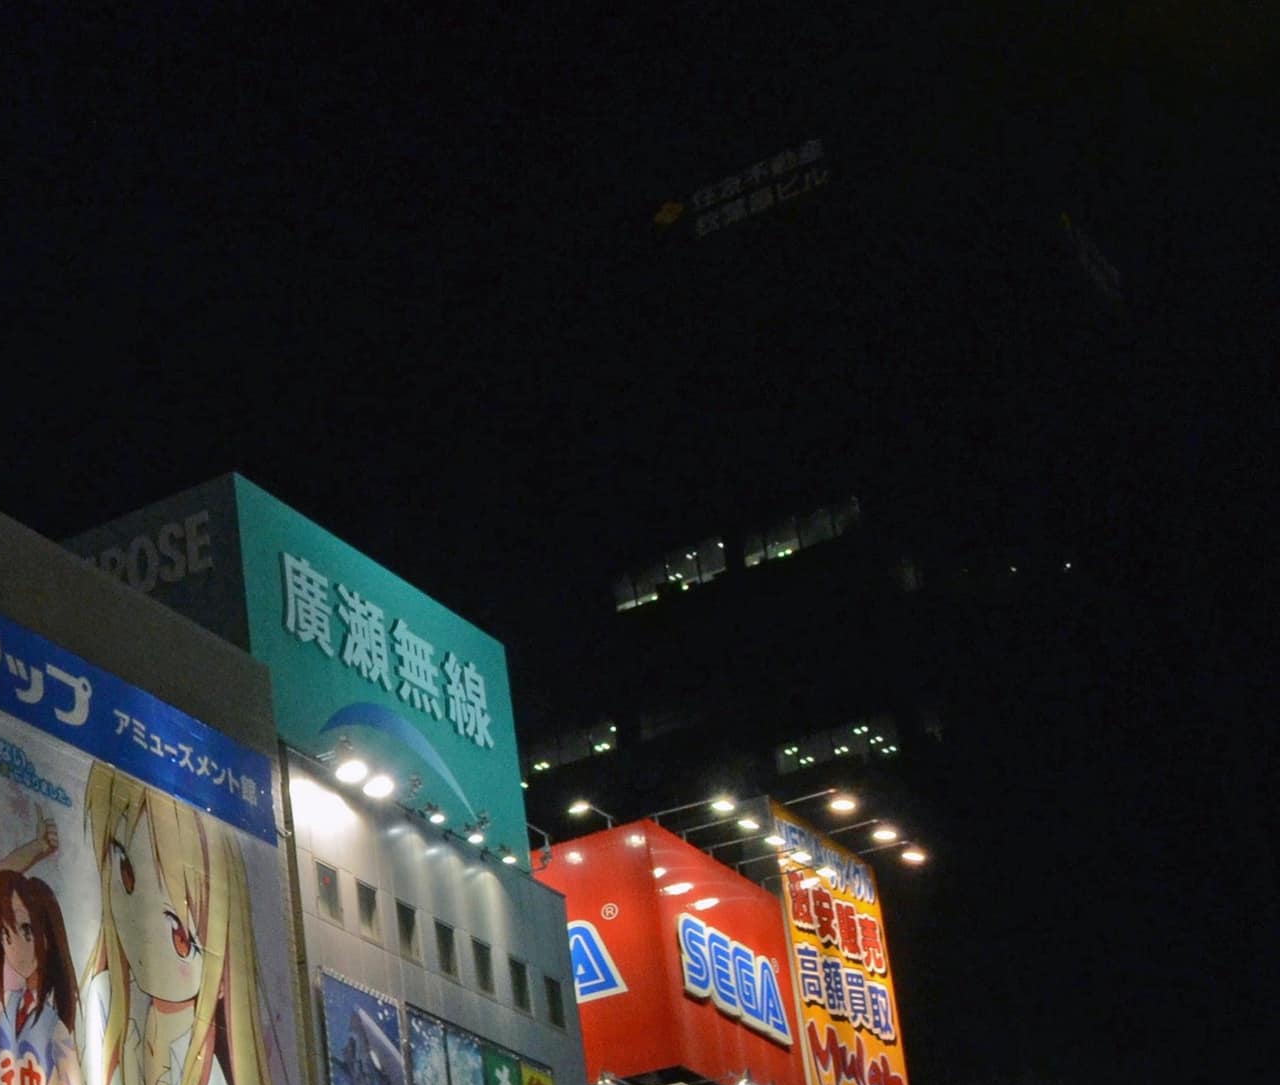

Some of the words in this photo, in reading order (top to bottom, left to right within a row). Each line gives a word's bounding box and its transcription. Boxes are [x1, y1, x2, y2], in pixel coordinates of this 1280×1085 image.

[113, 708, 259, 807] アミューズメント館
[787, 870, 887, 975] 激安販売
[677, 912, 793, 1047] SEGA
[797, 941, 897, 1041] 高額買取
